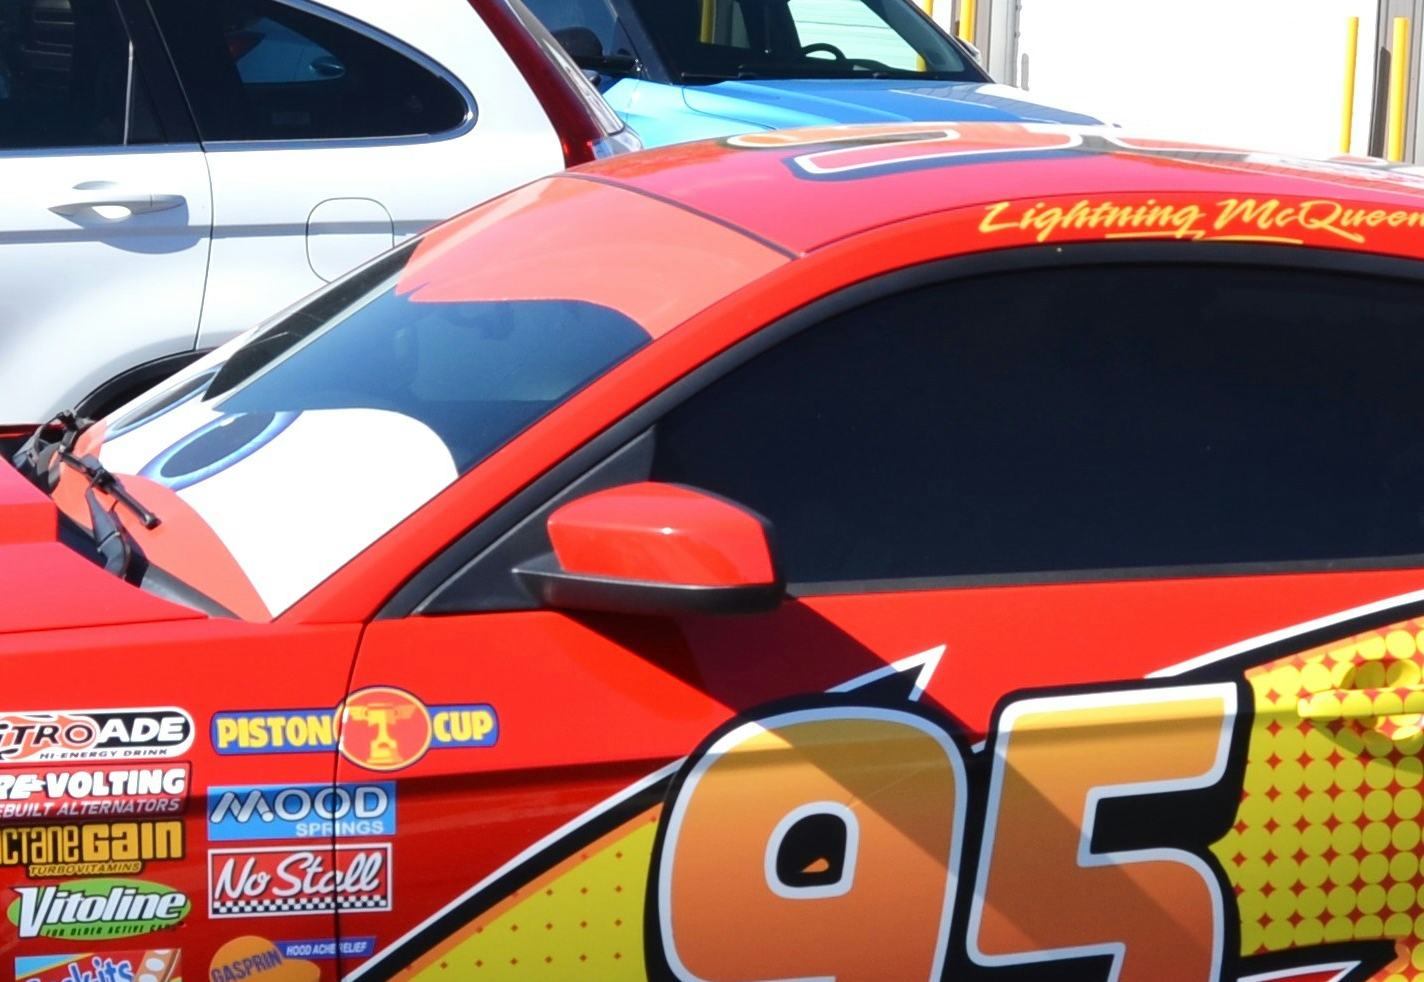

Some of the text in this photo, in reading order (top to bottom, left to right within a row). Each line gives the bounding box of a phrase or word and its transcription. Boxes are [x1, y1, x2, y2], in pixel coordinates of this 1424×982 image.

[978, 200, 1205, 242] Lightning
[216, 712, 494, 749] PISTON CUP
[123, 748, 168, 757] DRINK
[57, 798, 180, 817] ALTERNATORS
[209, 786, 389, 824] MOOD
[295, 820, 385, 838] SPRINGS
[29, 861, 142, 877] TURBOVITAMINS
[214, 851, 383, 900] No Stall
[13, 885, 187, 938] Vitoline
[286, 943, 313, 957] HOOD
[313, 943, 337, 956] ACHE
